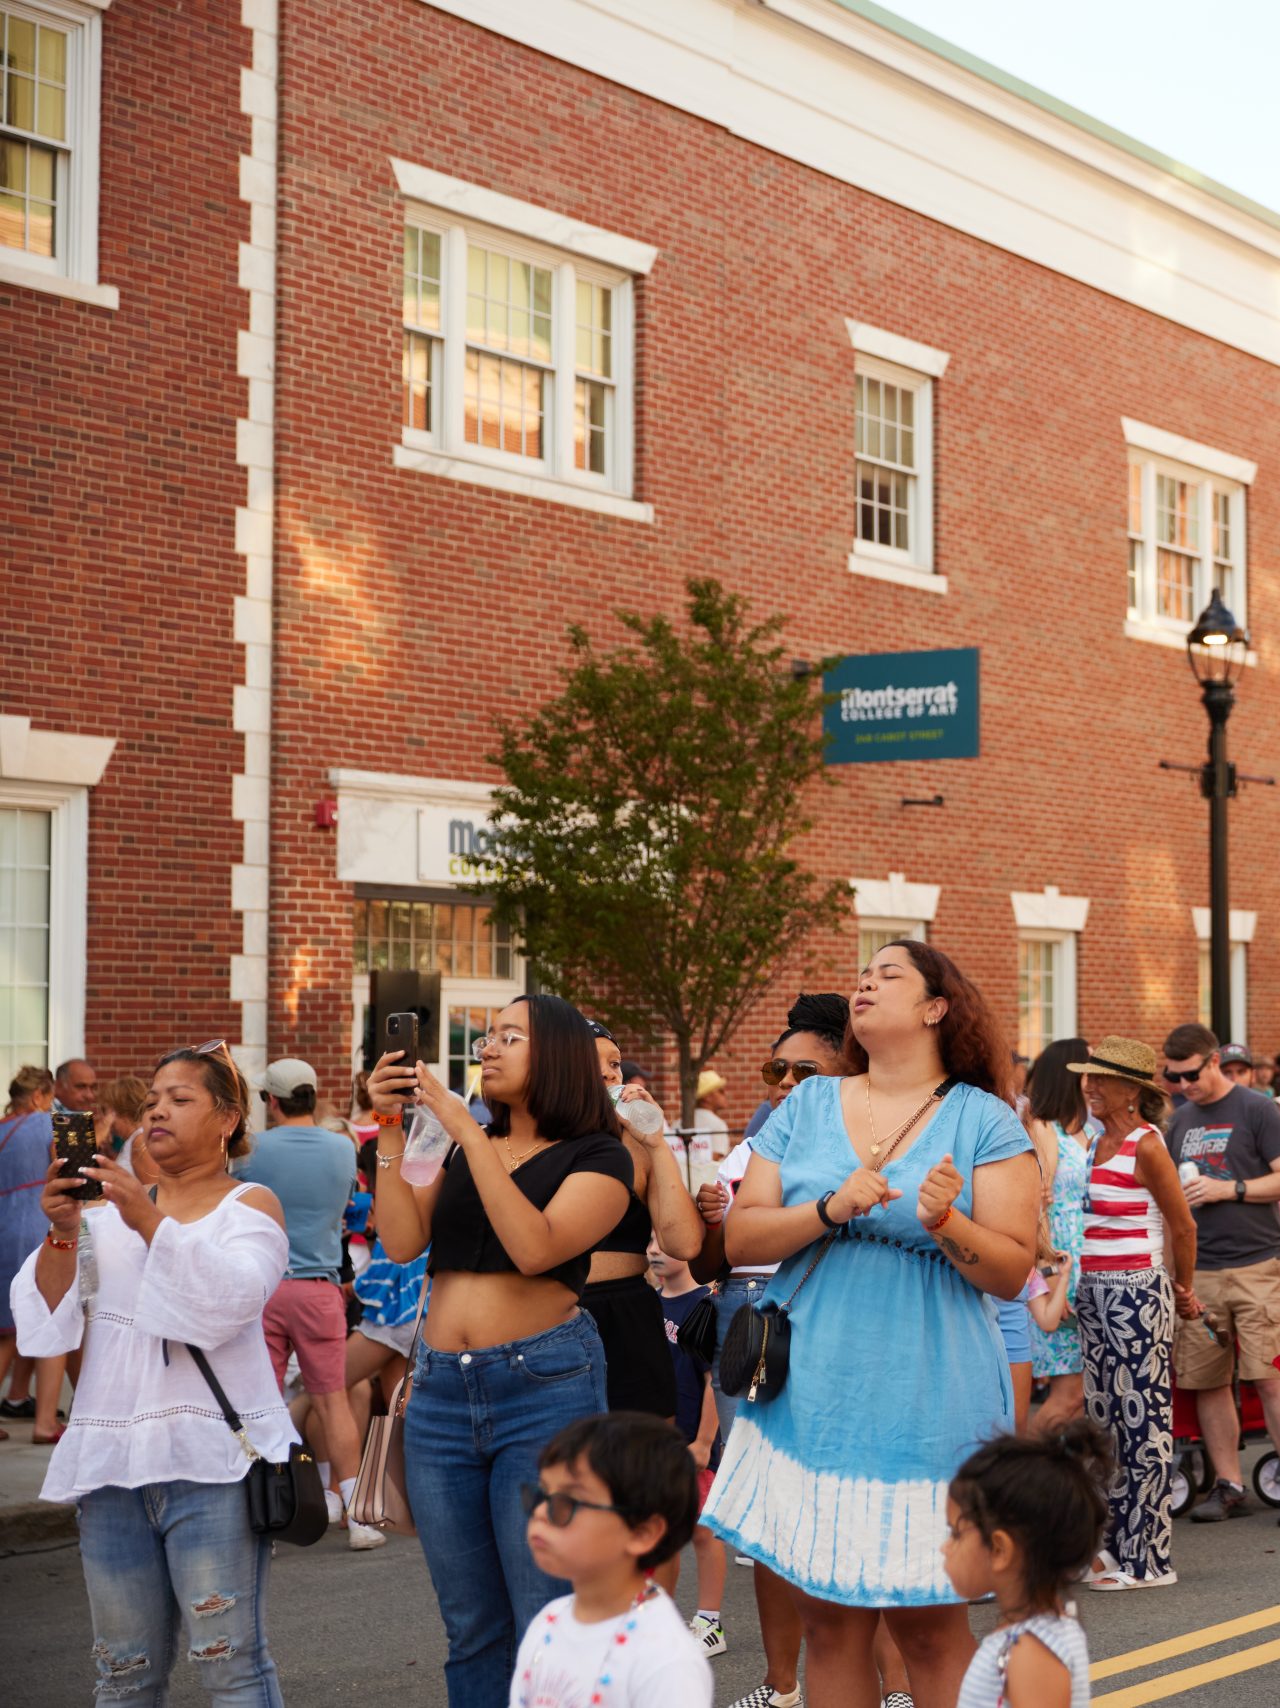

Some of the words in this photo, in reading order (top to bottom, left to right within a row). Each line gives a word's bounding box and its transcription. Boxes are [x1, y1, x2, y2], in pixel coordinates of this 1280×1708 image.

[841, 706, 902, 722] COLLEGE
[907, 702, 924, 717] OF
[928, 699, 957, 716] ART
[1182, 1126, 1206, 1146] FOO
[1180, 1137, 1229, 1159] FIGHTERS
